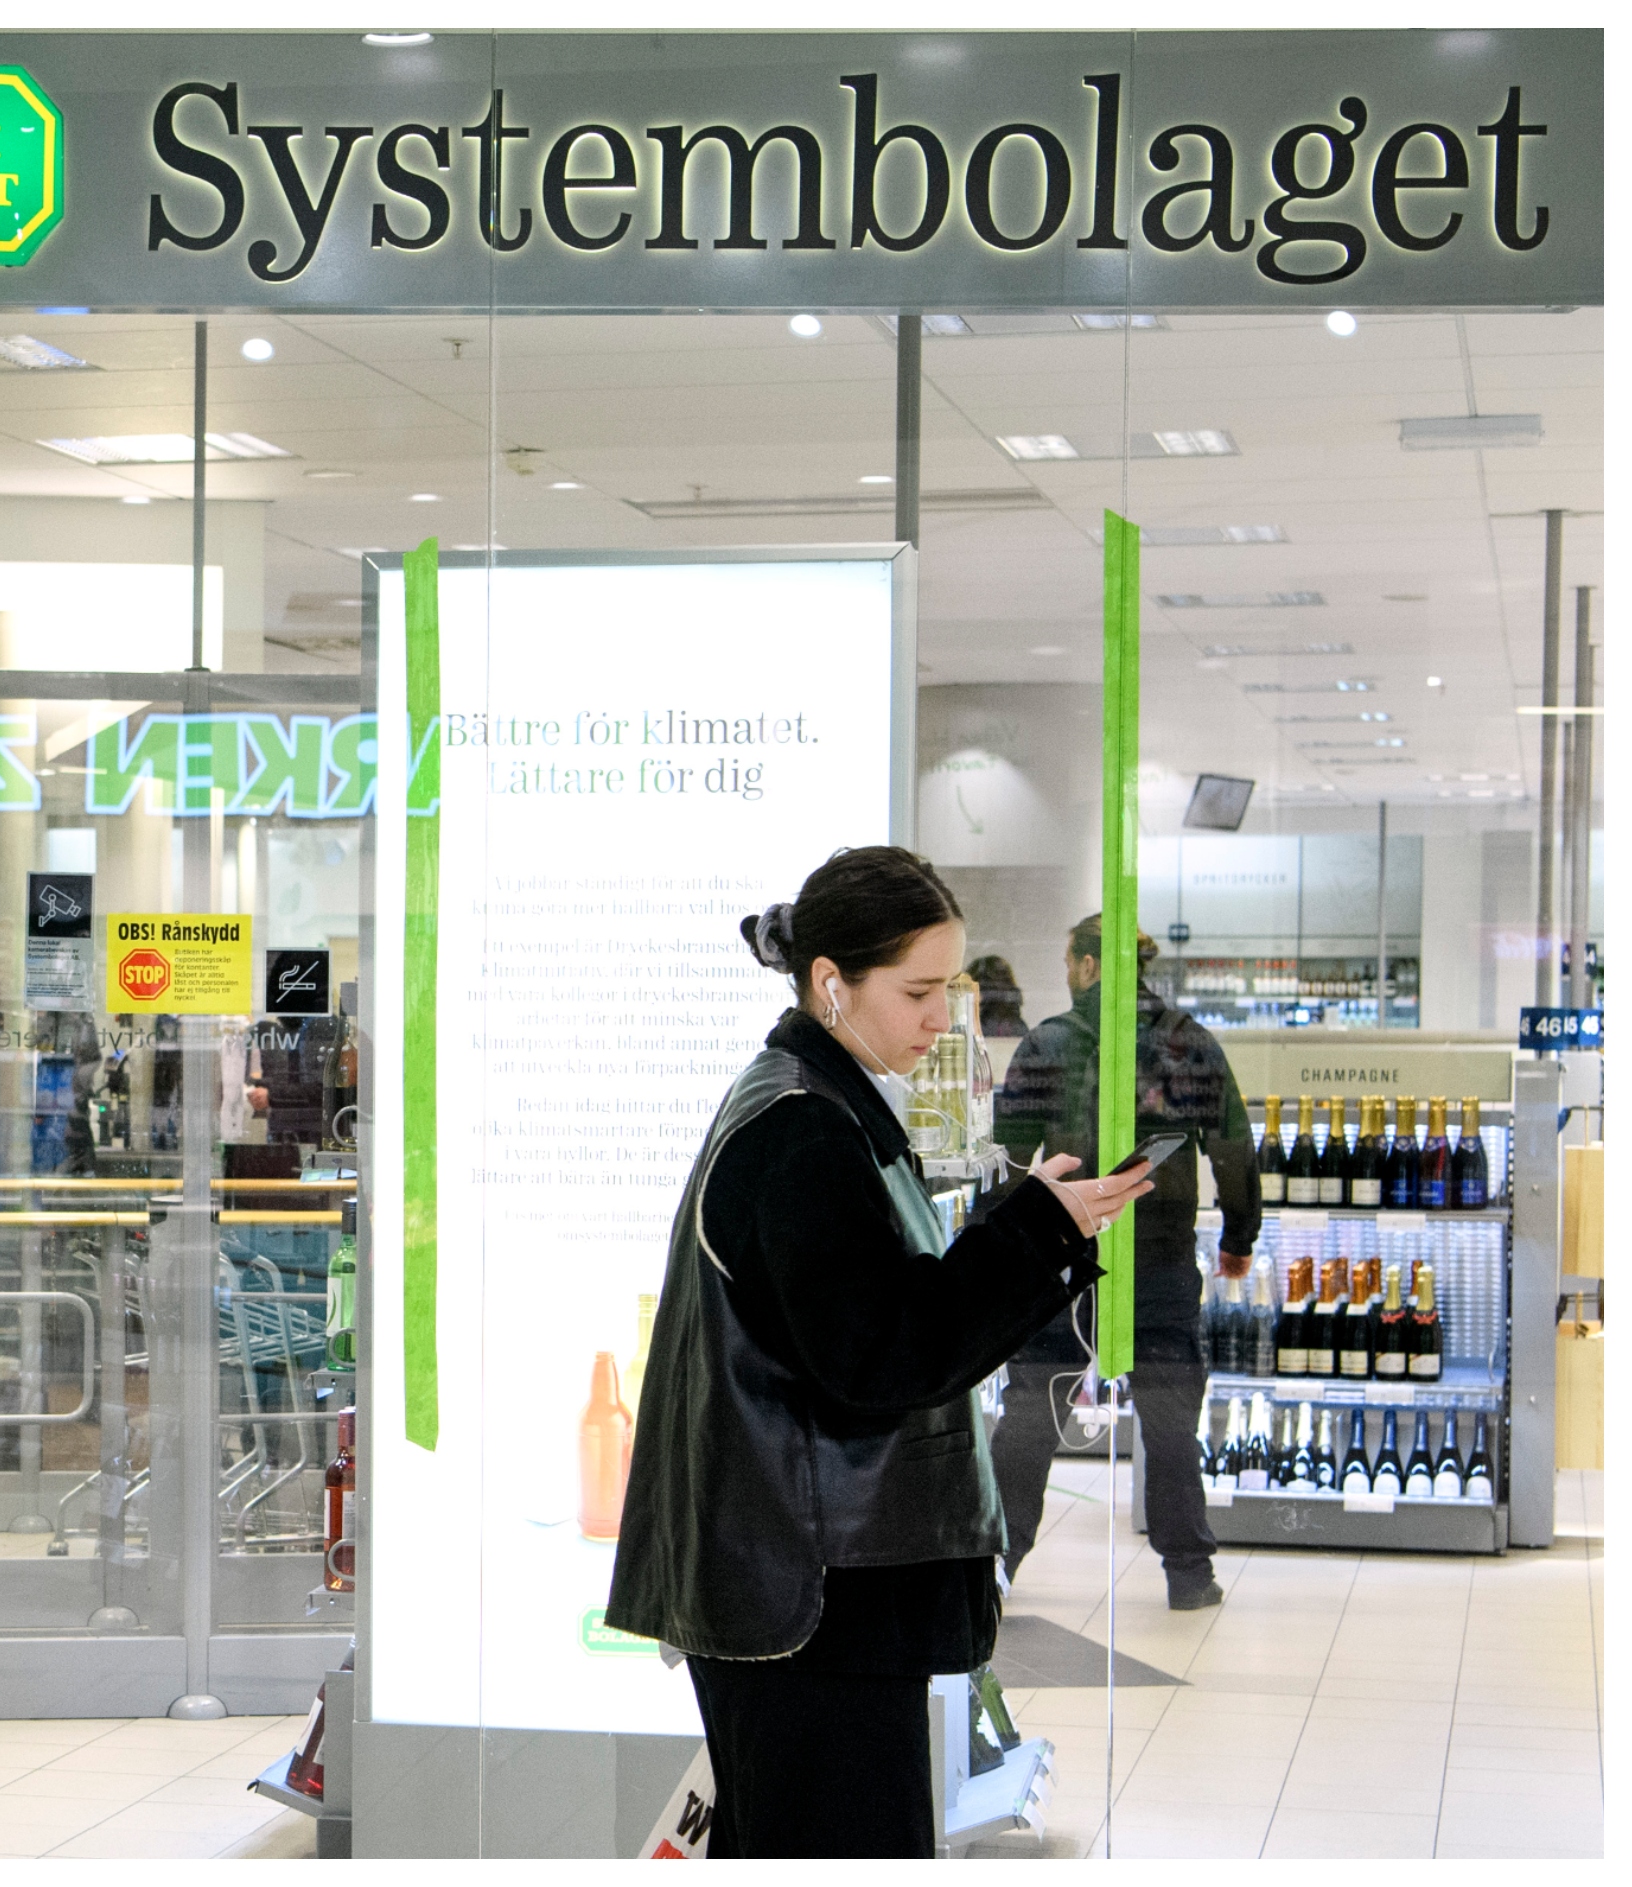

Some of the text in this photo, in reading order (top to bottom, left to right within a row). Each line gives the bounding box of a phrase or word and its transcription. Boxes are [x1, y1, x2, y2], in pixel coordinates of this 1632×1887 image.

[147, 72, 1550, 285] Systembolaget
[445, 710, 819, 746] Bättre för klimatet.
[489, 758, 765, 801] Lättare för dig
[118, 920, 240, 945] OBS! Rånskydd
[125, 965, 165, 985] STOP
[1534, 1015, 1563, 1038] 46
[1300, 1067, 1400, 1083] CHAMPAGNE
